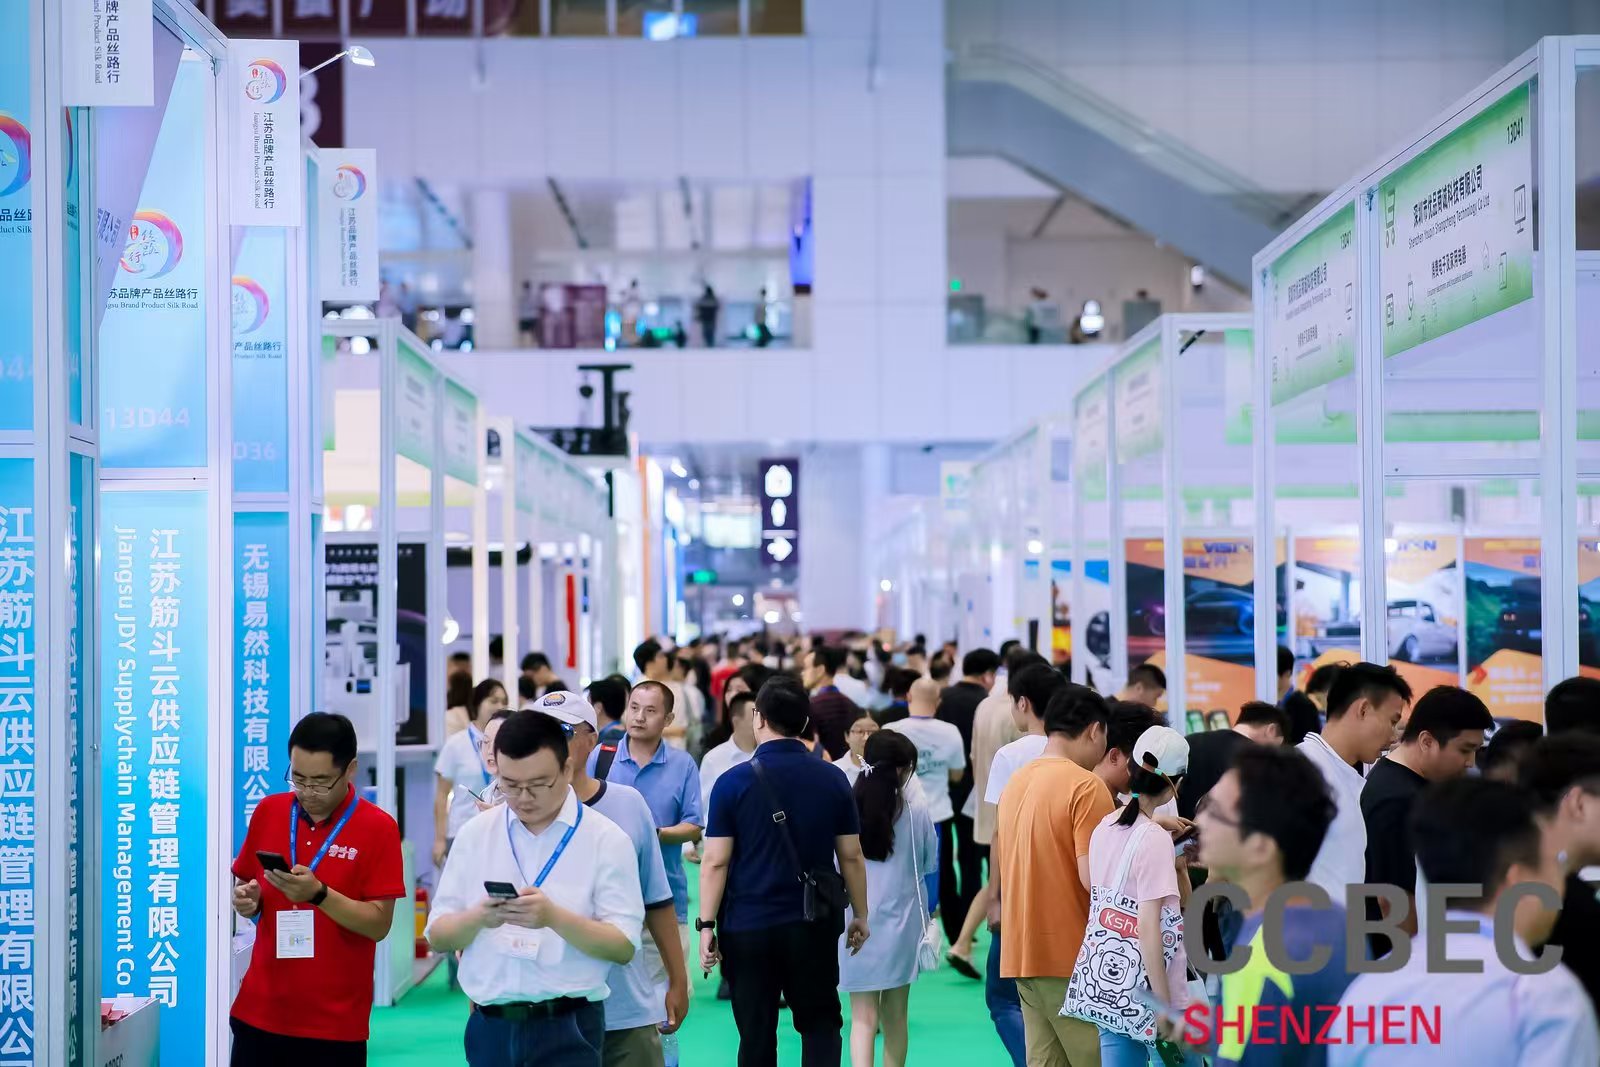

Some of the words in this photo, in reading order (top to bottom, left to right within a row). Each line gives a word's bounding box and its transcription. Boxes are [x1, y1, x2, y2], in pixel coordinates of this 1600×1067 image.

[106, 0, 120, 83] 牌产品丝路行
[263, 112, 275, 209] 江苏品牌产品丝路行
[1507, 117, 1523, 144] 13D41
[120, 301, 140, 309] Brand
[141, 301, 166, 309] Product
[167, 301, 180, 309] Silk
[181, 301, 199, 309] Road
[114, 525, 137, 609] Jiangsu
[114, 613, 137, 652] JDY
[114, 658, 138, 796] Supplychain
[147, 527, 181, 1008] 江苏筋斗云供应链管理有限公司
[0, 506, 34, 1067] 江苏筋斗云供应链管理有限公
[113, 803, 137, 953] Management
[1121, 897, 1138, 911] RI
[116, 958, 135, 986] Co
